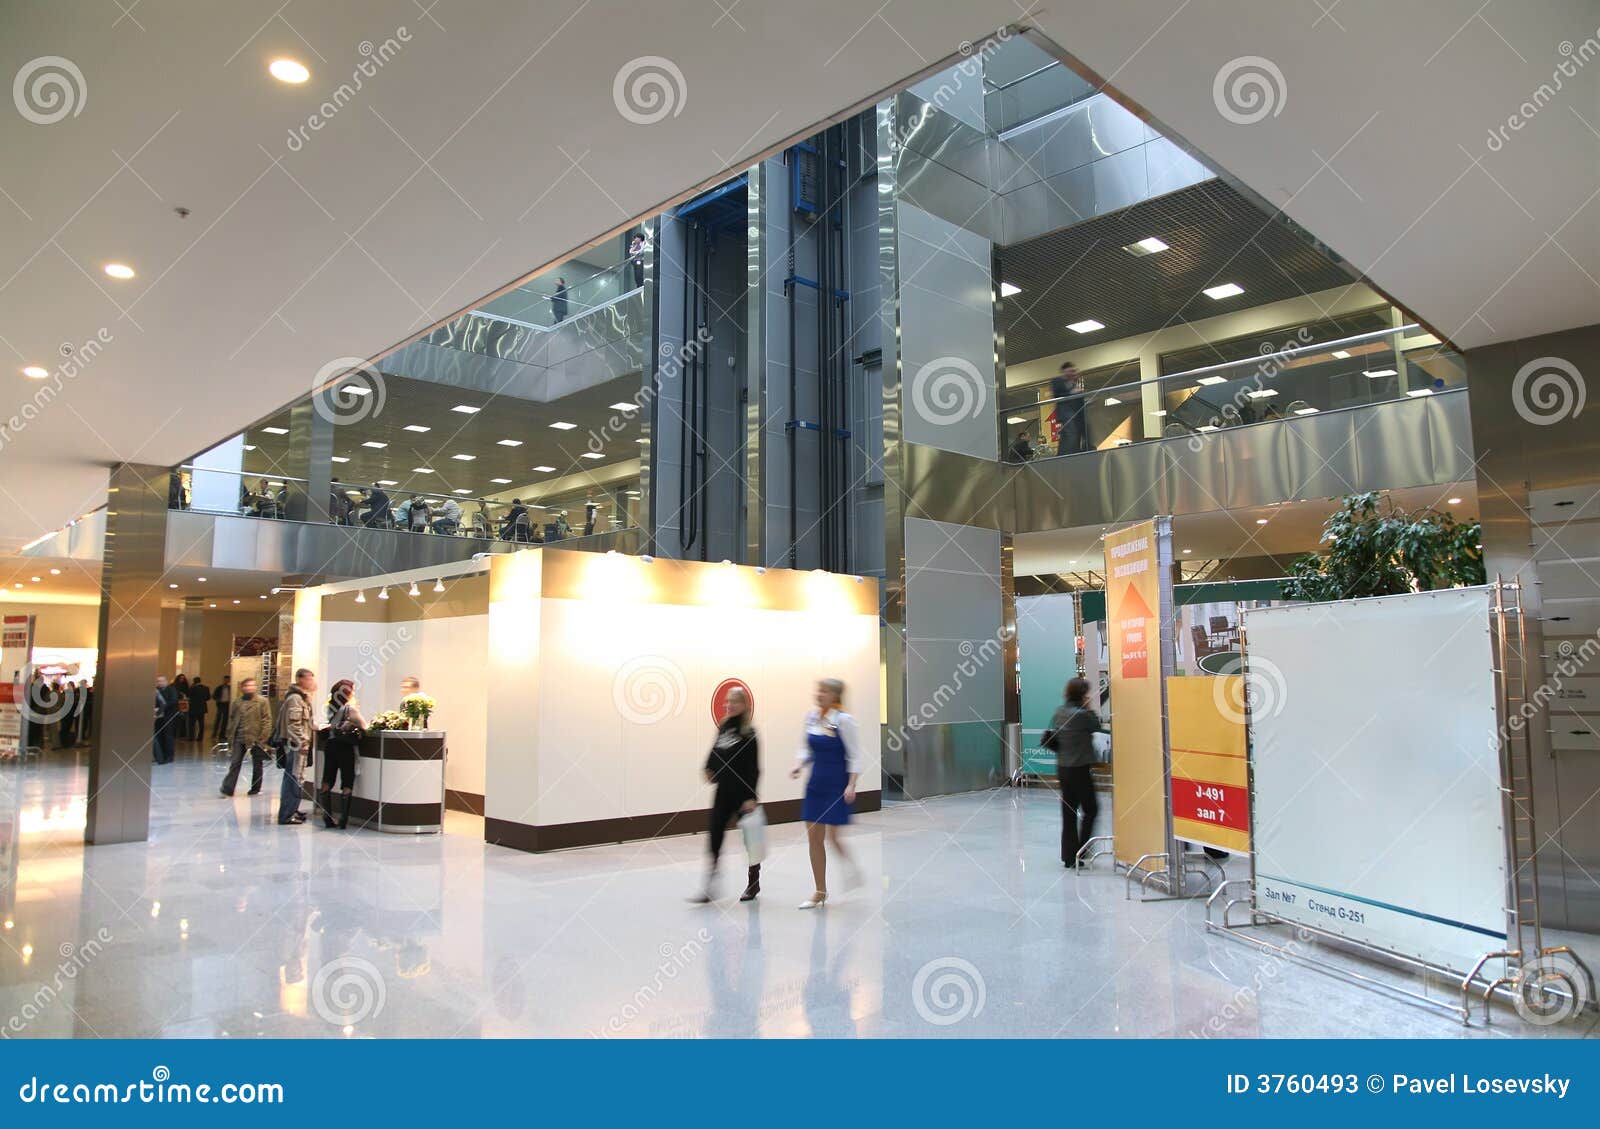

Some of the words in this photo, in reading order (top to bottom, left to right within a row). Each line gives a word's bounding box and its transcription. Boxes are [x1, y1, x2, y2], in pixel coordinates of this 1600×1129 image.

[1195, 785, 1225, 802] J-491
[1196, 807, 1216, 821] зал
[1217, 808, 1225, 823] 7
[1264, 887, 1280, 900] Зал
[1282, 891, 1297, 904] №7
[1308, 898, 1336, 918] Стенд
[1338, 907, 1365, 924] G-251
